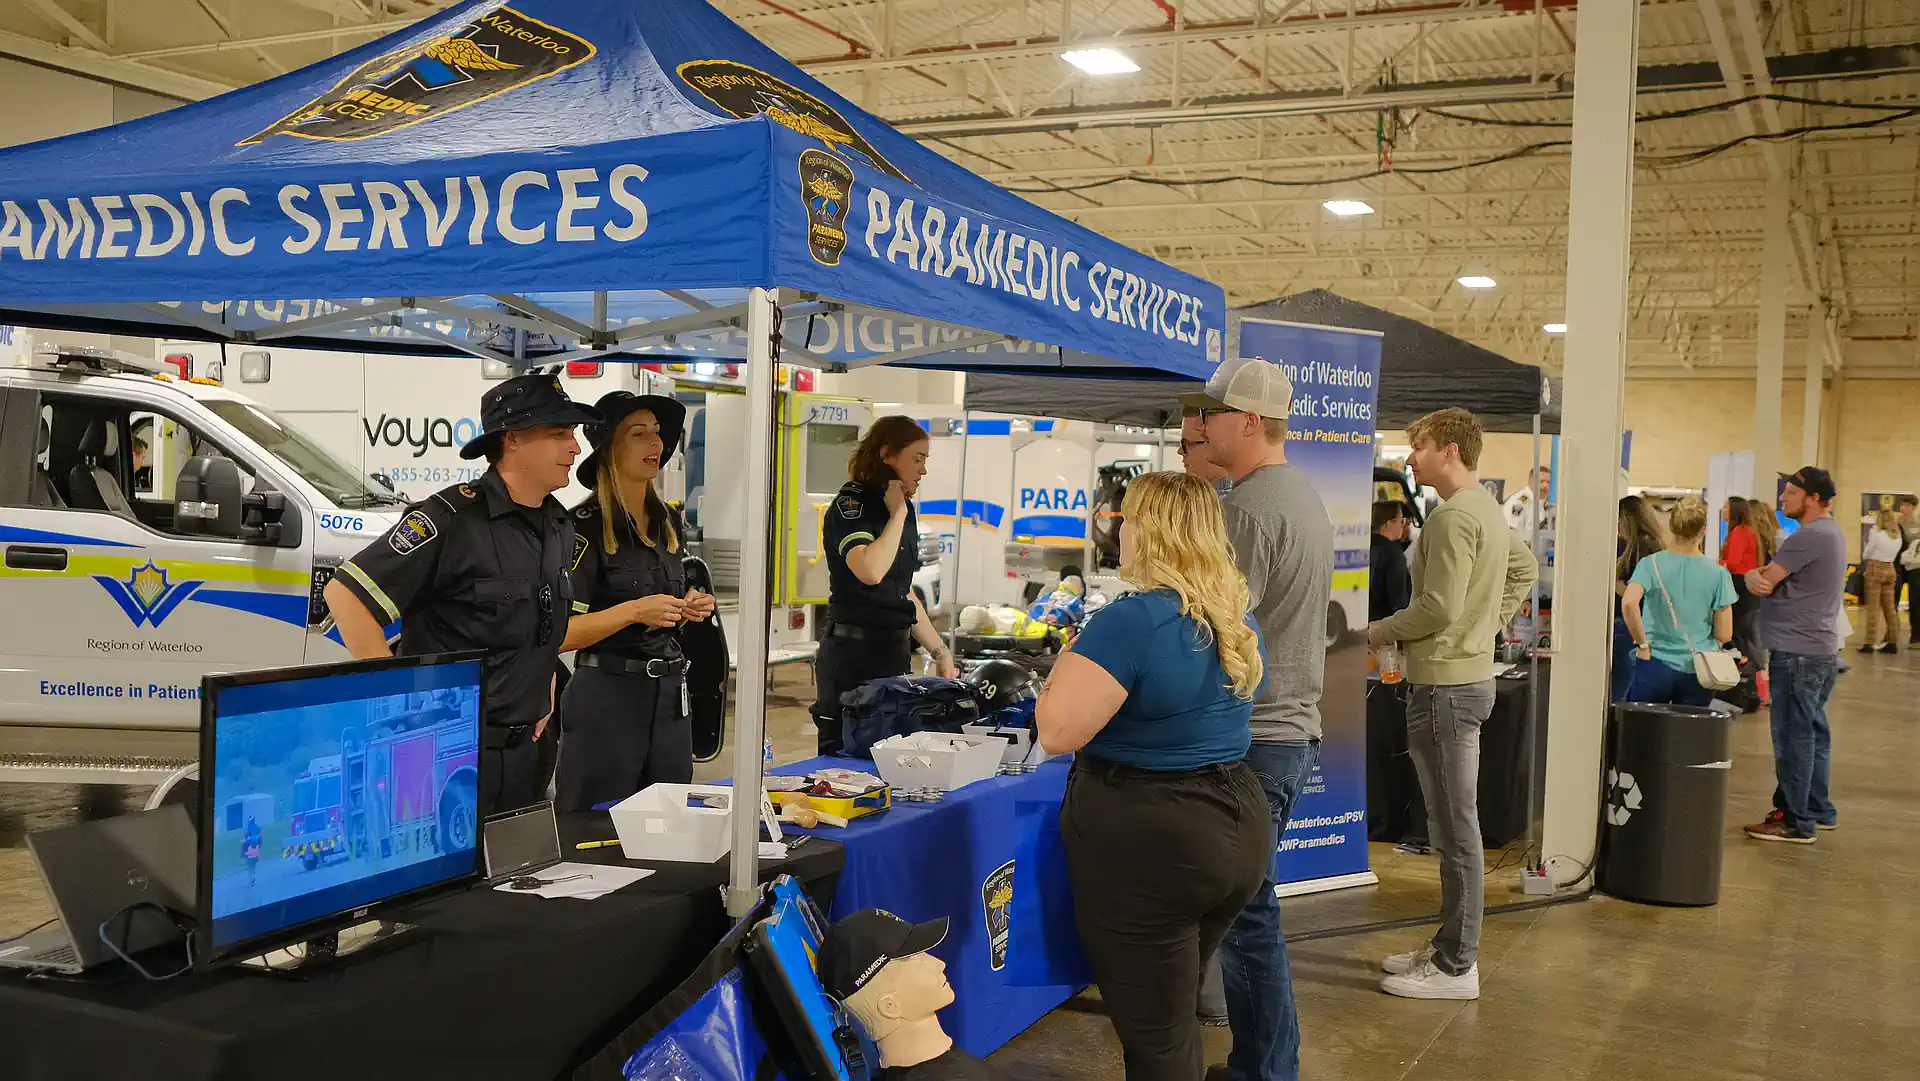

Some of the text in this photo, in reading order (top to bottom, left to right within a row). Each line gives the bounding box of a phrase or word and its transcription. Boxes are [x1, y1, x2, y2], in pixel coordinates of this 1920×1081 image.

[480, 14, 570, 54] Waterloo
[277, 163, 650, 255] SERVICES
[814, 235, 839, 248] SERVICES
[865, 187, 1204, 346] PARAMEDIC SERVICES
[1301, 360, 1316, 383] of
[1317, 362, 1372, 388] Waterloo
[822, 405, 848, 420] 7791
[1290, 393, 1372, 420] edic Services
[1303, 429, 1313, 441] in
[1315, 429, 1350, 444] Patient
[1351, 432, 1371, 444] Care
[379, 467, 487, 482] 1-855-263-716
[1021, 488, 1096, 510] PARA
[320, 514, 364, 531] 5076
[87, 638, 203, 653] Region of Waterloo
[40, 680, 203, 700] Excellence in Patient
[979, 679, 998, 700] 29
[854, 953, 888, 988] PARAMEDIC
